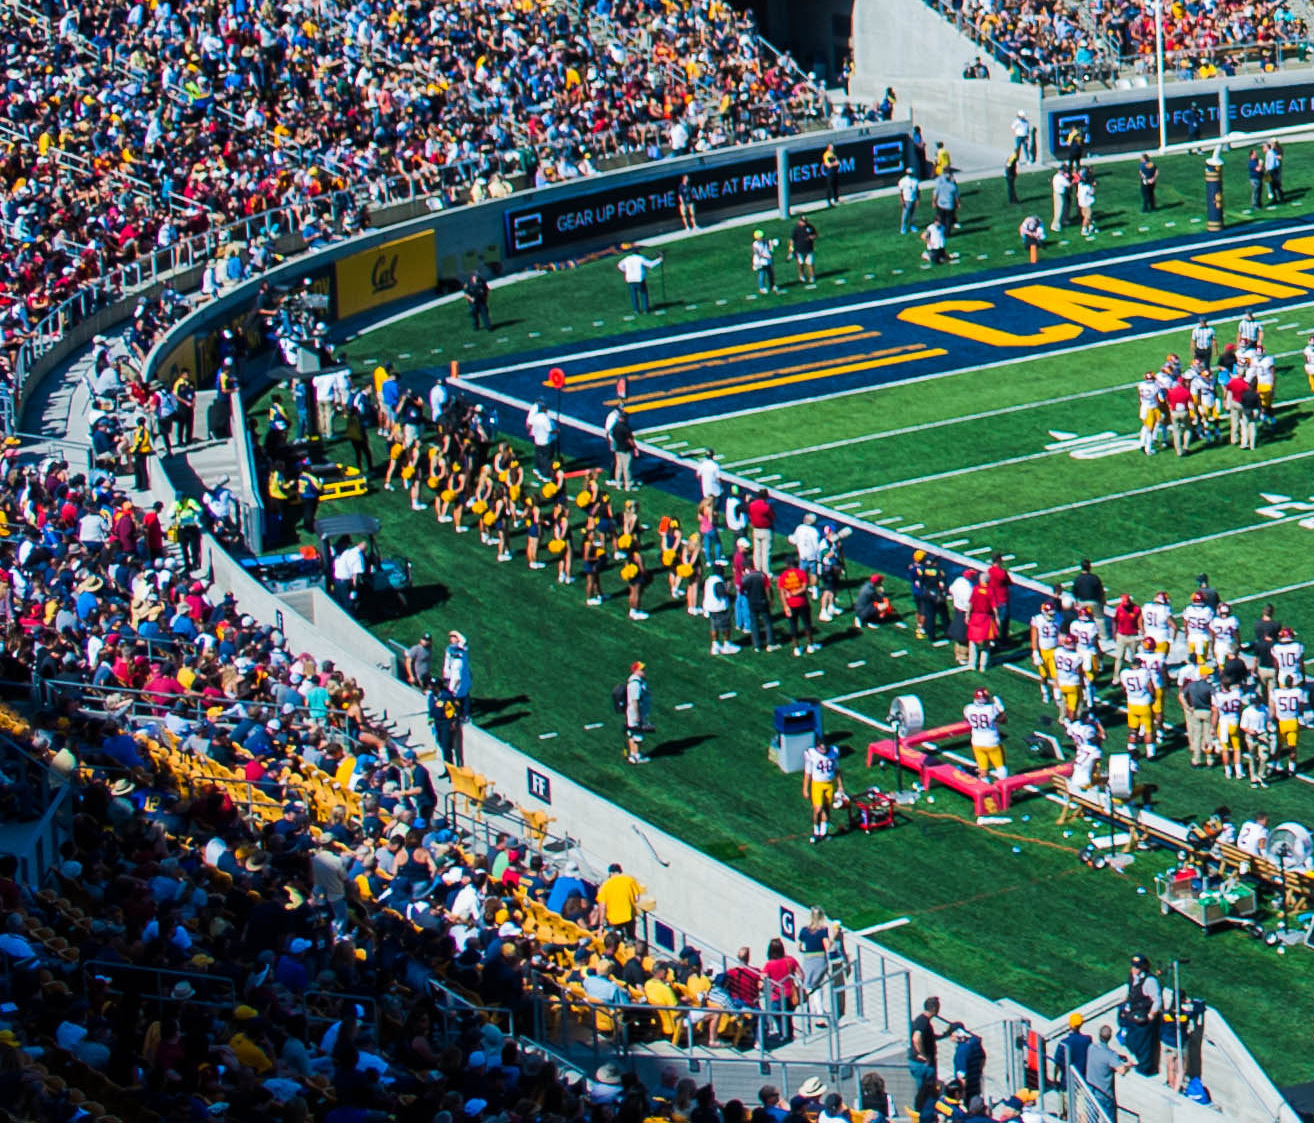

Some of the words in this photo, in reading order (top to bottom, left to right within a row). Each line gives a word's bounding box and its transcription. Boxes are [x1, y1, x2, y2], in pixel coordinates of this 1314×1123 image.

[1106, 116, 1147, 134] GEAR
[1207, 104, 1238, 121] TE
[1240, 99, 1285, 118] GAME
[1288, 97, 1307, 114] AT
[556, 208, 592, 232] GEAR
[595, 202, 615, 222] UP
[617, 196, 647, 218] FOR
[649, 190, 675, 209] THE
[686, 180, 719, 201] AME
[722, 178, 741, 196] AT
[743, 157, 856, 191] FANCEST.CM
[371, 254, 399, 295] Cal
[1280, 652, 1297, 667] 10
[1126, 677, 1142, 691] 51
[1278, 696, 1299, 712] 50
[532, 774, 546, 796] FF
[781, 913, 793, 935] G
